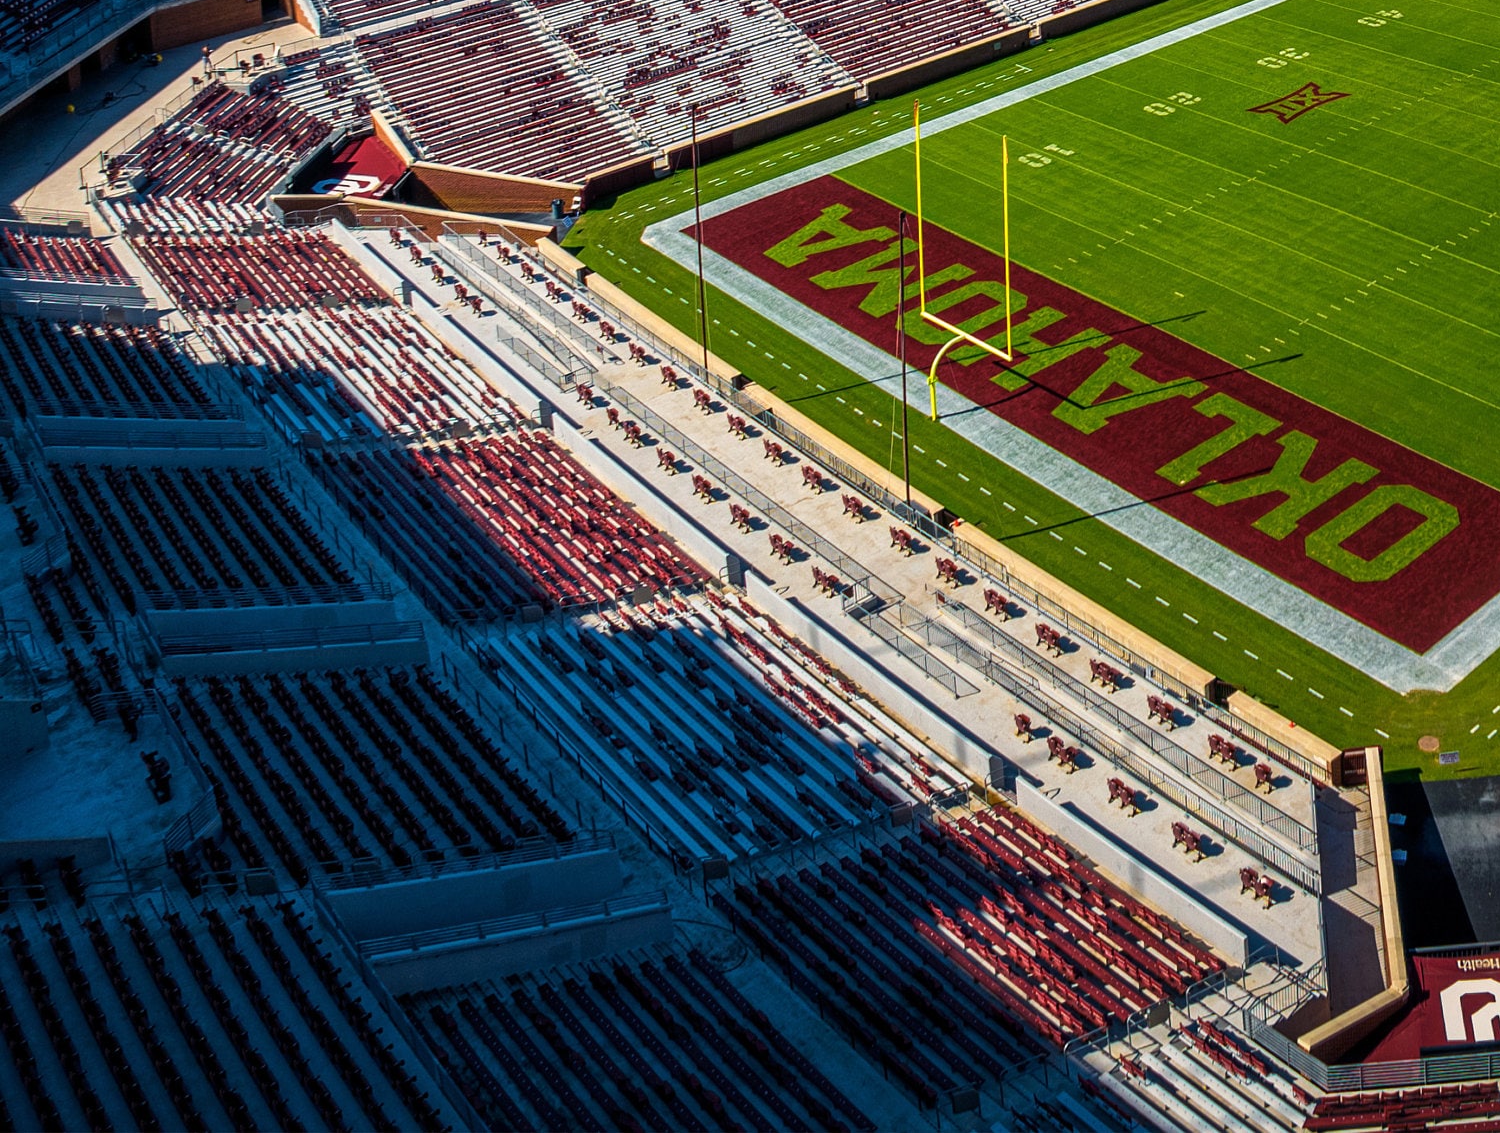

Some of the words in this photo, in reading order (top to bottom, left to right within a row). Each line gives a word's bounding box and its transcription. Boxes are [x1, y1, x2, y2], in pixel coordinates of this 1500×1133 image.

[1357, 9, 1403, 27] 40
[1256, 47, 1309, 69] 30
[1143, 91, 1202, 116] 20
[1018, 143, 1075, 168] 10
[763, 203, 1461, 583] OKLAHOMA
[1457, 958, 1500, 972] Health
